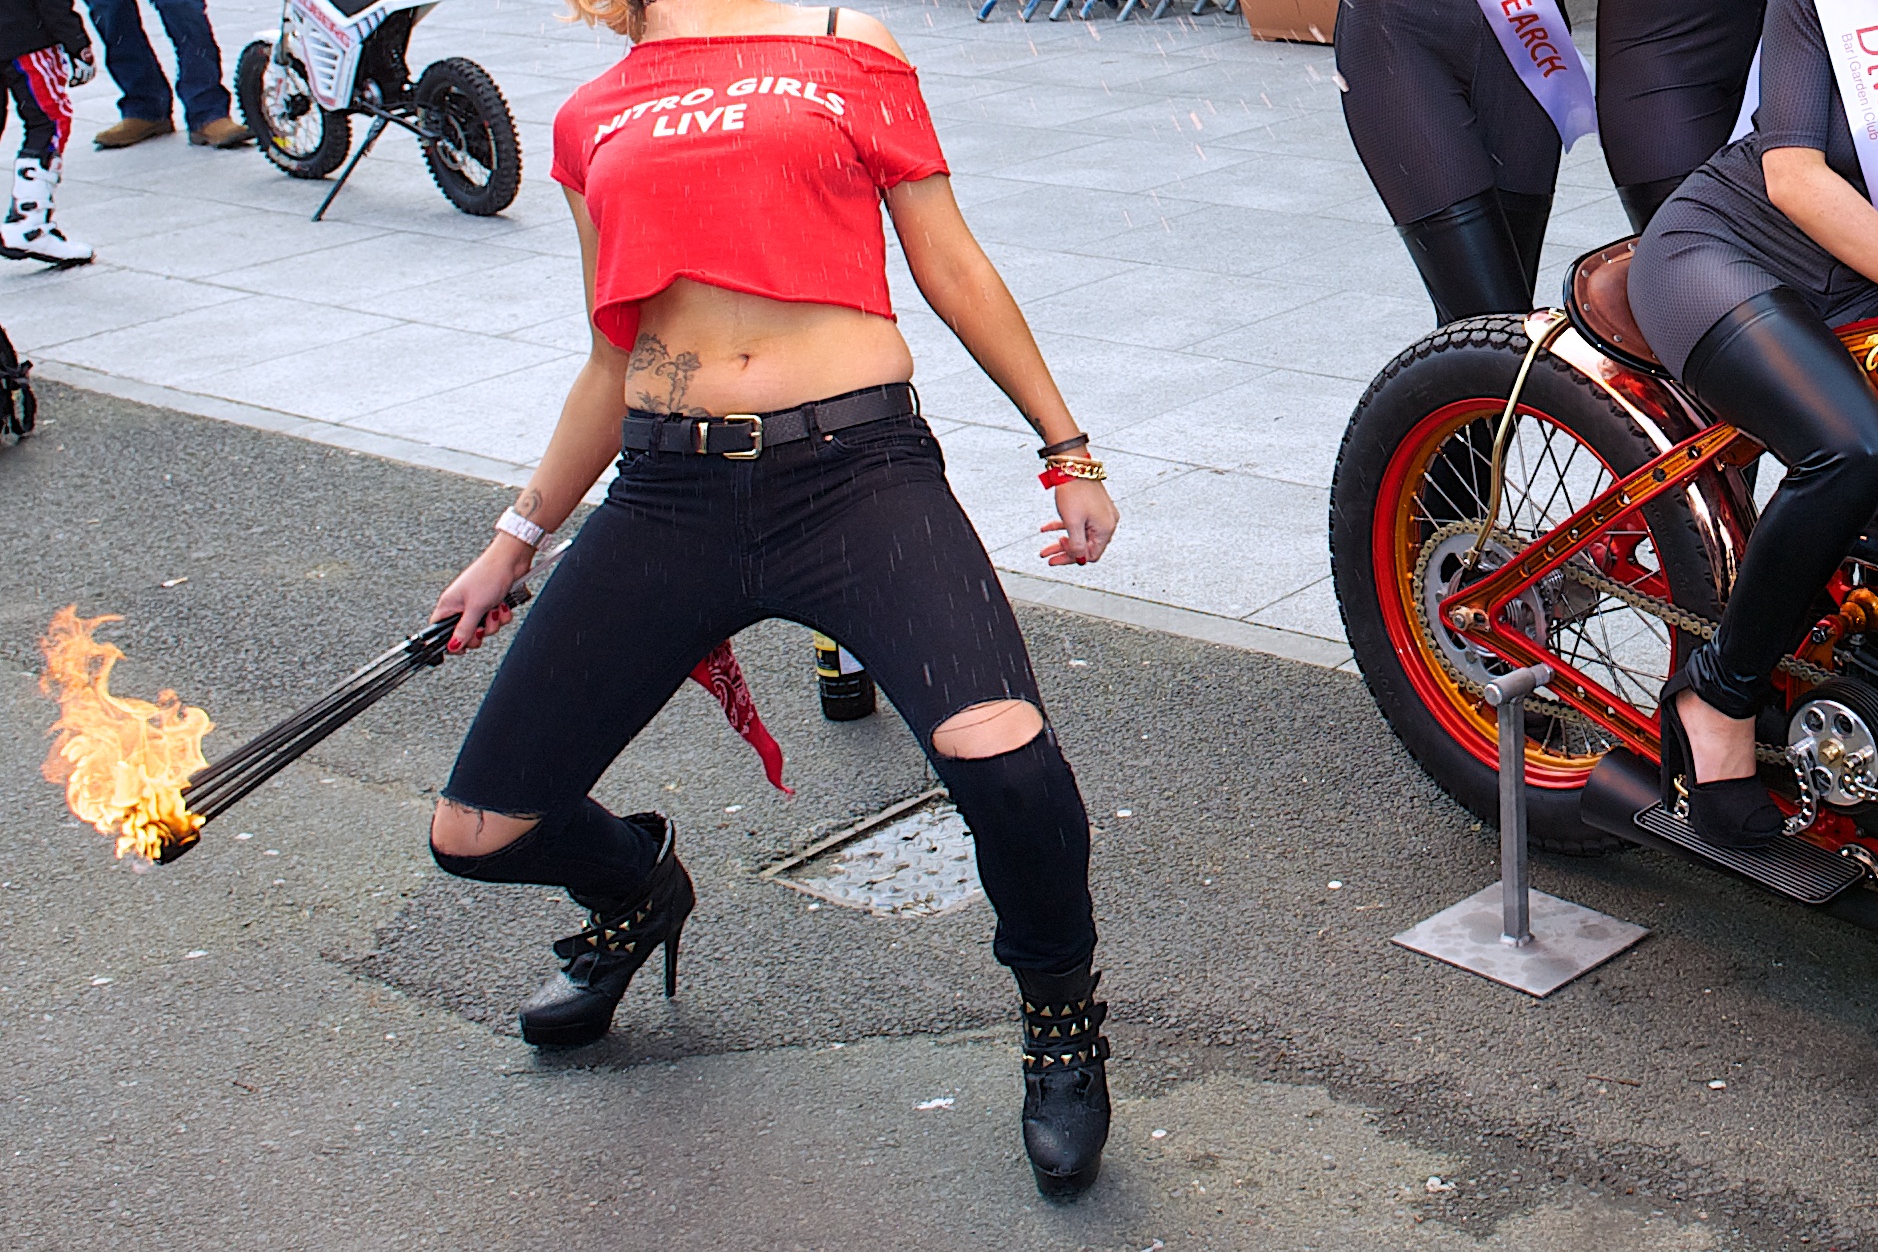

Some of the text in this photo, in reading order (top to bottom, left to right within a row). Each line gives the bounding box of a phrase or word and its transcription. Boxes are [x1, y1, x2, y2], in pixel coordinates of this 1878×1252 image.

[594, 76, 845, 145] NITRO GIRLS
[652, 103, 748, 137] LIVE
